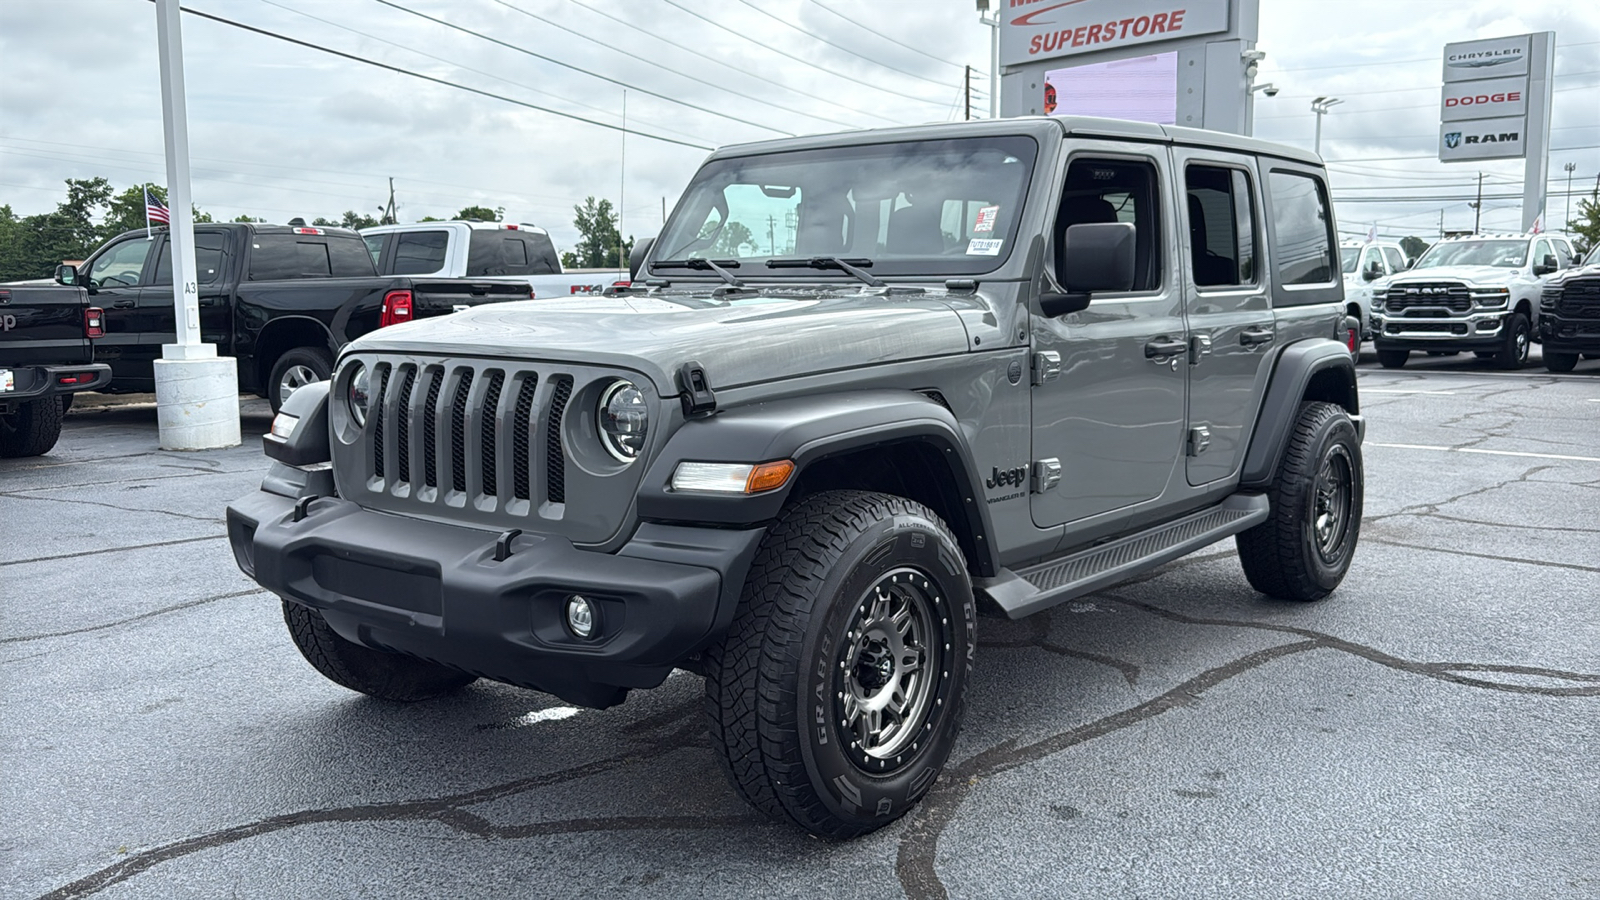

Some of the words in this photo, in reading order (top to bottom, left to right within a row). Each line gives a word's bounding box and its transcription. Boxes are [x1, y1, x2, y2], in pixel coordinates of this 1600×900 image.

[1028, 9, 1186, 55] SUPERSTORE
[1448, 48, 1522, 61] CHRYSLER
[1445, 91, 1521, 107] DODGE
[1464, 132, 1519, 144] RAM
[184, 282, 197, 295] A3
[570, 284, 603, 295] FX4
[0, 314, 16, 332] p
[986, 465, 1026, 490] Jeep
